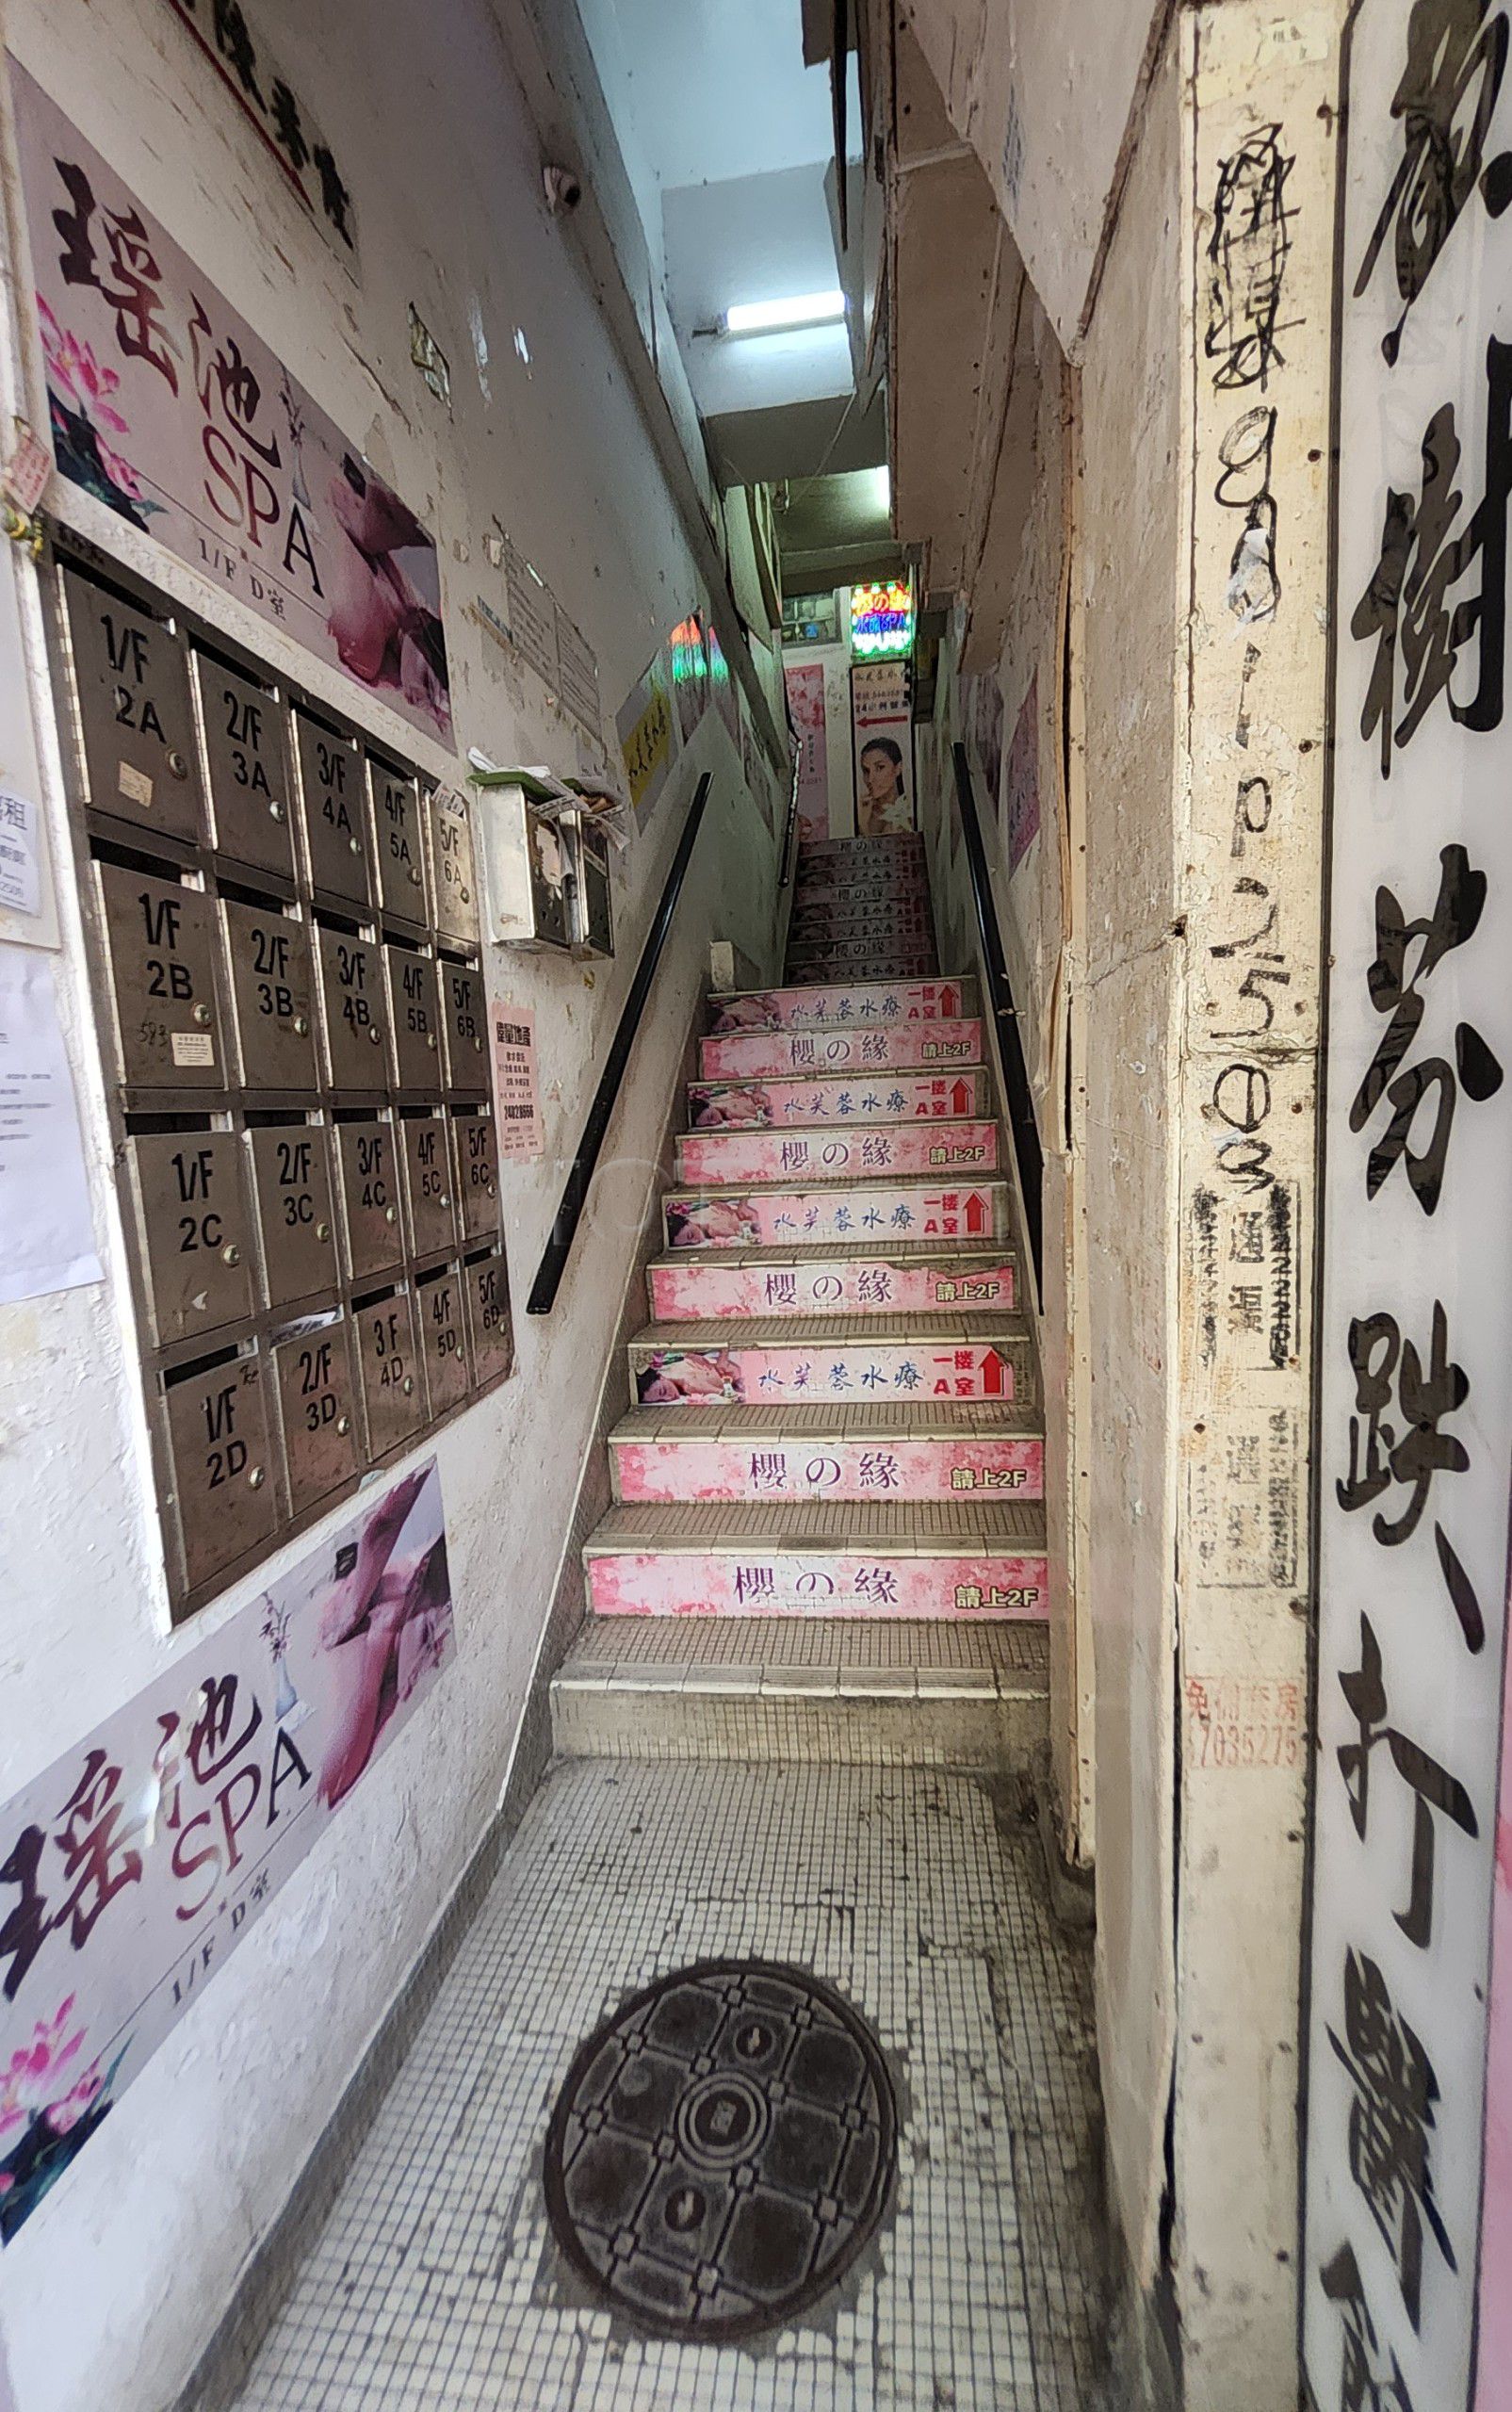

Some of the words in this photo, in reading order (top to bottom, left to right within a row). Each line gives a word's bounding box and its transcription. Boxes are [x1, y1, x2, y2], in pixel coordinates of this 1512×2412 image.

[202, 424, 325, 600] SPA
[197, 534, 236, 582] 1/F
[100, 614, 150, 683] 1/F
[114, 691, 166, 744] 2A
[223, 691, 263, 751] 2/F
[234, 751, 271, 798] 3A
[317, 742, 347, 792] 3/F
[323, 800, 350, 835] 4A
[384, 784, 405, 827] 4/F
[390, 832, 411, 865] 5A
[439, 818, 459, 857] 5/F
[444, 860, 463, 887] 6A
[138, 893, 181, 950] 1/F
[252, 928, 289, 980] 2/F
[337, 944, 366, 989] 3/F
[147, 960, 194, 1001] 2B
[403, 964, 423, 1002] 4/F
[452, 978, 471, 1011] 5/F
[257, 982, 295, 1018] 3B
[342, 995, 370, 1027] 4B
[407, 1007, 427, 1033] 5B
[457, 1015, 475, 1037] 6B
[921, 1041, 971, 1059] 請上2F
[357, 1135, 383, 1178] 3/F
[417, 1130, 435, 1166] 4/F
[468, 1127, 486, 1159] 5/F
[929, 1146, 985, 1165] 請上2F
[171, 1149, 214, 1204] 1/F
[277, 1142, 311, 1186] 2/F
[471, 1159, 489, 1186] 6C
[362, 1181, 387, 1210] 4C
[421, 1169, 441, 1197] 5C
[284, 1194, 314, 1226] 3C
[179, 1214, 223, 1254] 2C
[479, 1271, 496, 1305] 5/F
[935, 1282, 1000, 1302] 請上2F
[432, 1289, 451, 1325] 4/F
[483, 1306, 500, 1330] 6D
[438, 1328, 457, 1359] 5D
[299, 1342, 331, 1395] 2/F
[381, 1356, 403, 1387] 4D
[204, 1384, 237, 1443] 1/F
[306, 1393, 336, 1431] 3D
[205, 1440, 248, 1490] 2D
[951, 1467, 1027, 1491] 請上2F
[954, 1585, 1038, 1610] 請上2F
[171, 1728, 312, 1921] SPA
[172, 1935, 216, 2005] 1/F
